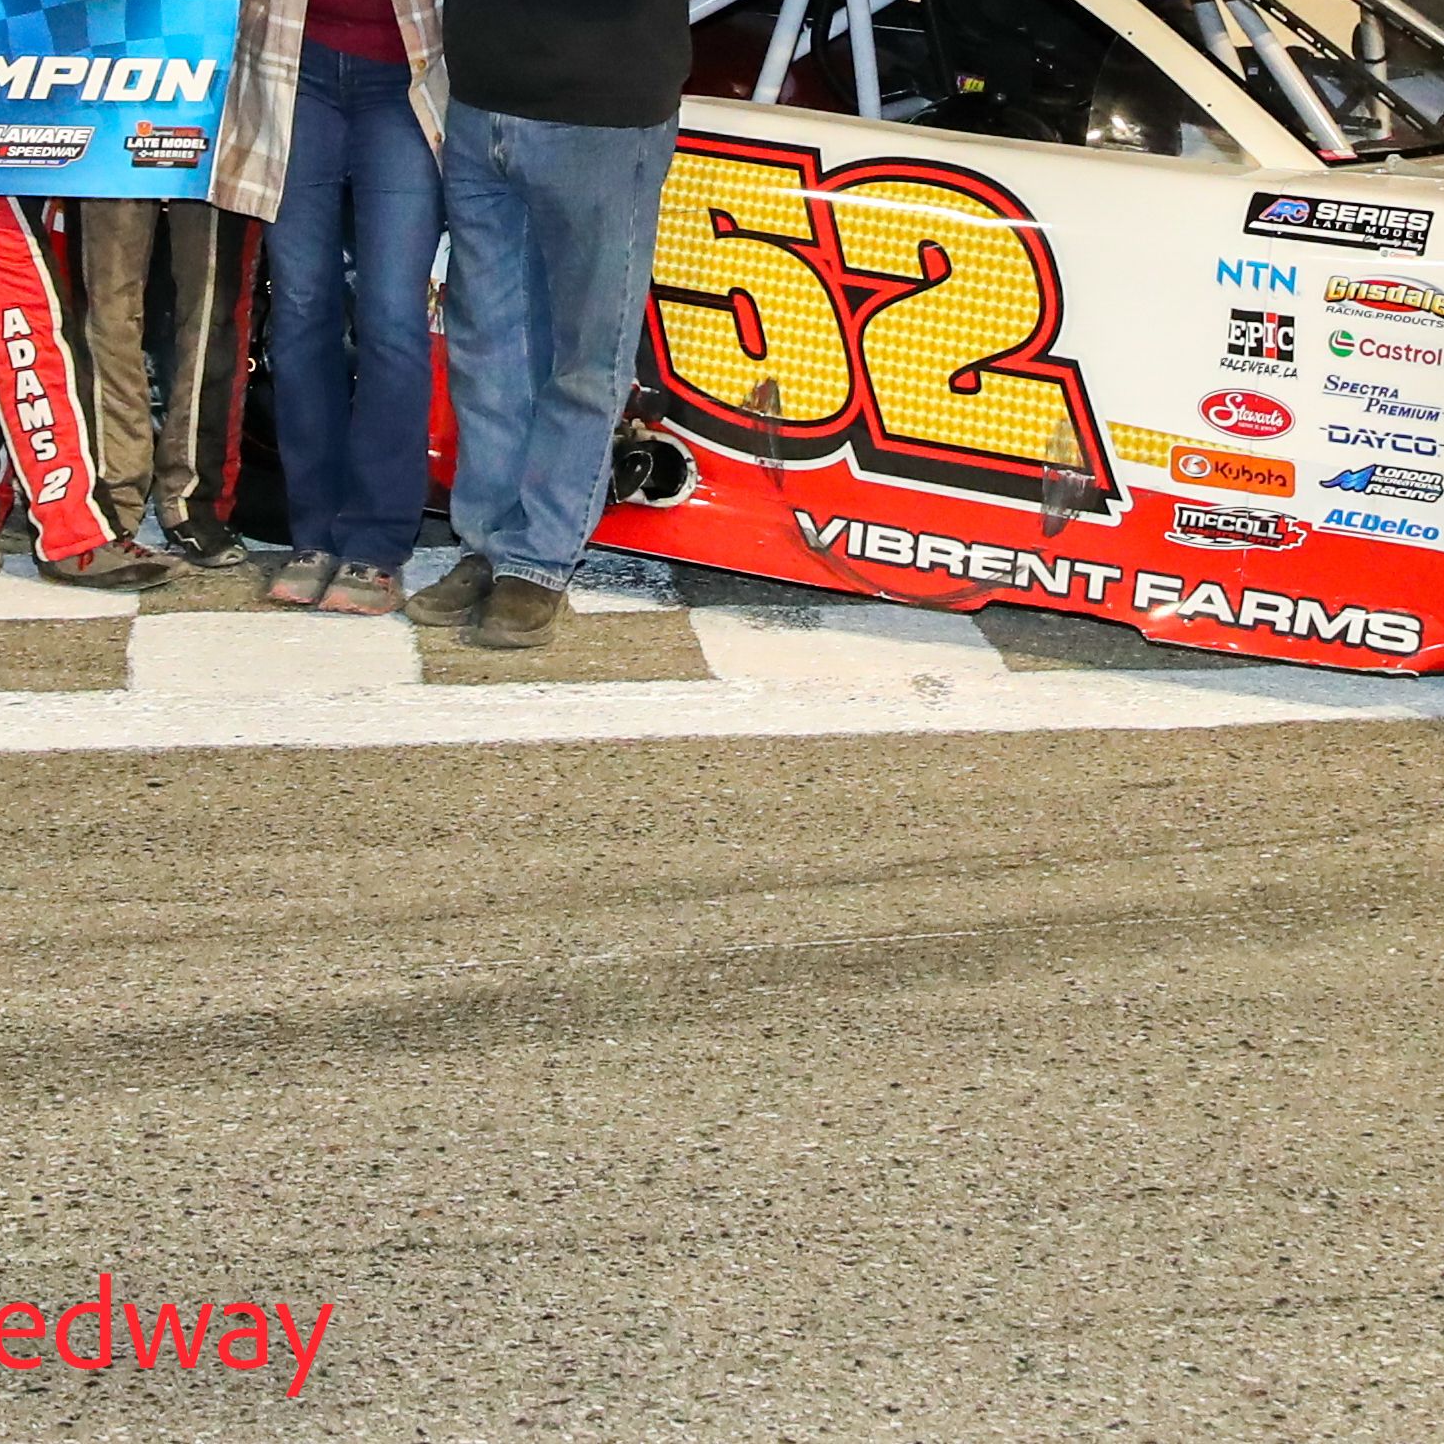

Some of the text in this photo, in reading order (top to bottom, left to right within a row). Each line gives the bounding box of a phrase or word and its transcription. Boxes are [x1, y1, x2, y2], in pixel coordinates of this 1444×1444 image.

[6, 146, 81, 157] SPEEDWAY
[127, 137, 206, 149] LATE MODEL
[1258, 198, 1429, 232] APC SERIES
[1312, 219, 1425, 240] LATE MODEL
[1217, 257, 1297, 295] NTN
[651, 146, 1081, 481] 52
[1325, 305, 1444, 329] RACING PRODUCTS
[1228, 319, 1295, 352] EPIC
[1359, 338, 1443, 366] Castrol
[1363, 397, 1441, 422] PREMIUM
[1327, 424, 1438, 457] DAYCO
[1214, 461, 1288, 488] Kubota
[1374, 465, 1442, 485] LONDON
[1323, 509, 1440, 541] ACDelco
[794, 510, 1424, 655] VIBRENT FARMS
